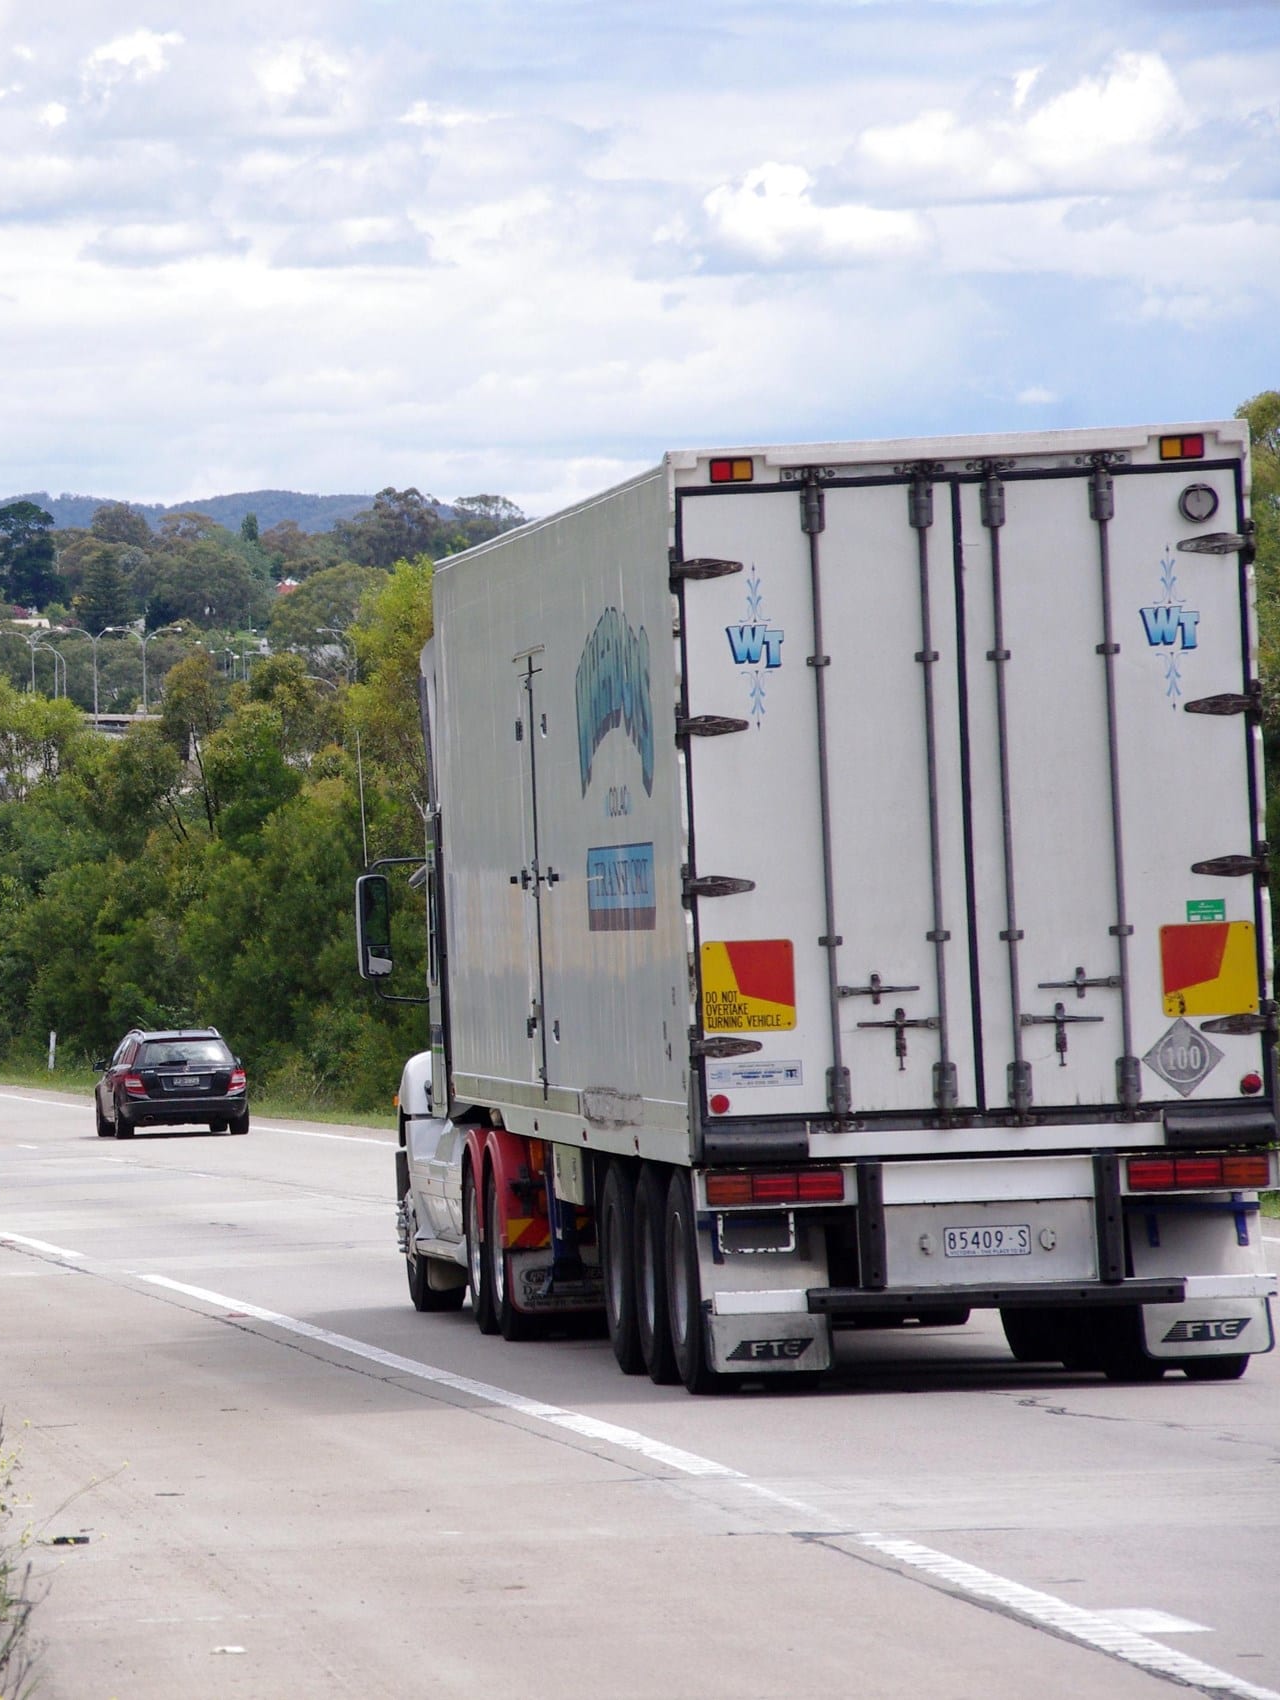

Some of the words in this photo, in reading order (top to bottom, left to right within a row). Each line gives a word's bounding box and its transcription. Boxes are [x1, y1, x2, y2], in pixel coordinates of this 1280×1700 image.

[1138, 605, 1200, 650] WT
[725, 626, 785, 669] WT
[705, 991, 718, 1004] DO
[721, 990, 738, 1003] NOT
[706, 1003, 749, 1016] OVERTAKE
[707, 1015, 743, 1029] TURNING
[746, 1014, 781, 1027] VEHICLE
[1166, 1045, 1202, 1071] 100
[1184, 1320, 1241, 1338] FTE
[750, 1340, 801, 1357] FTE
